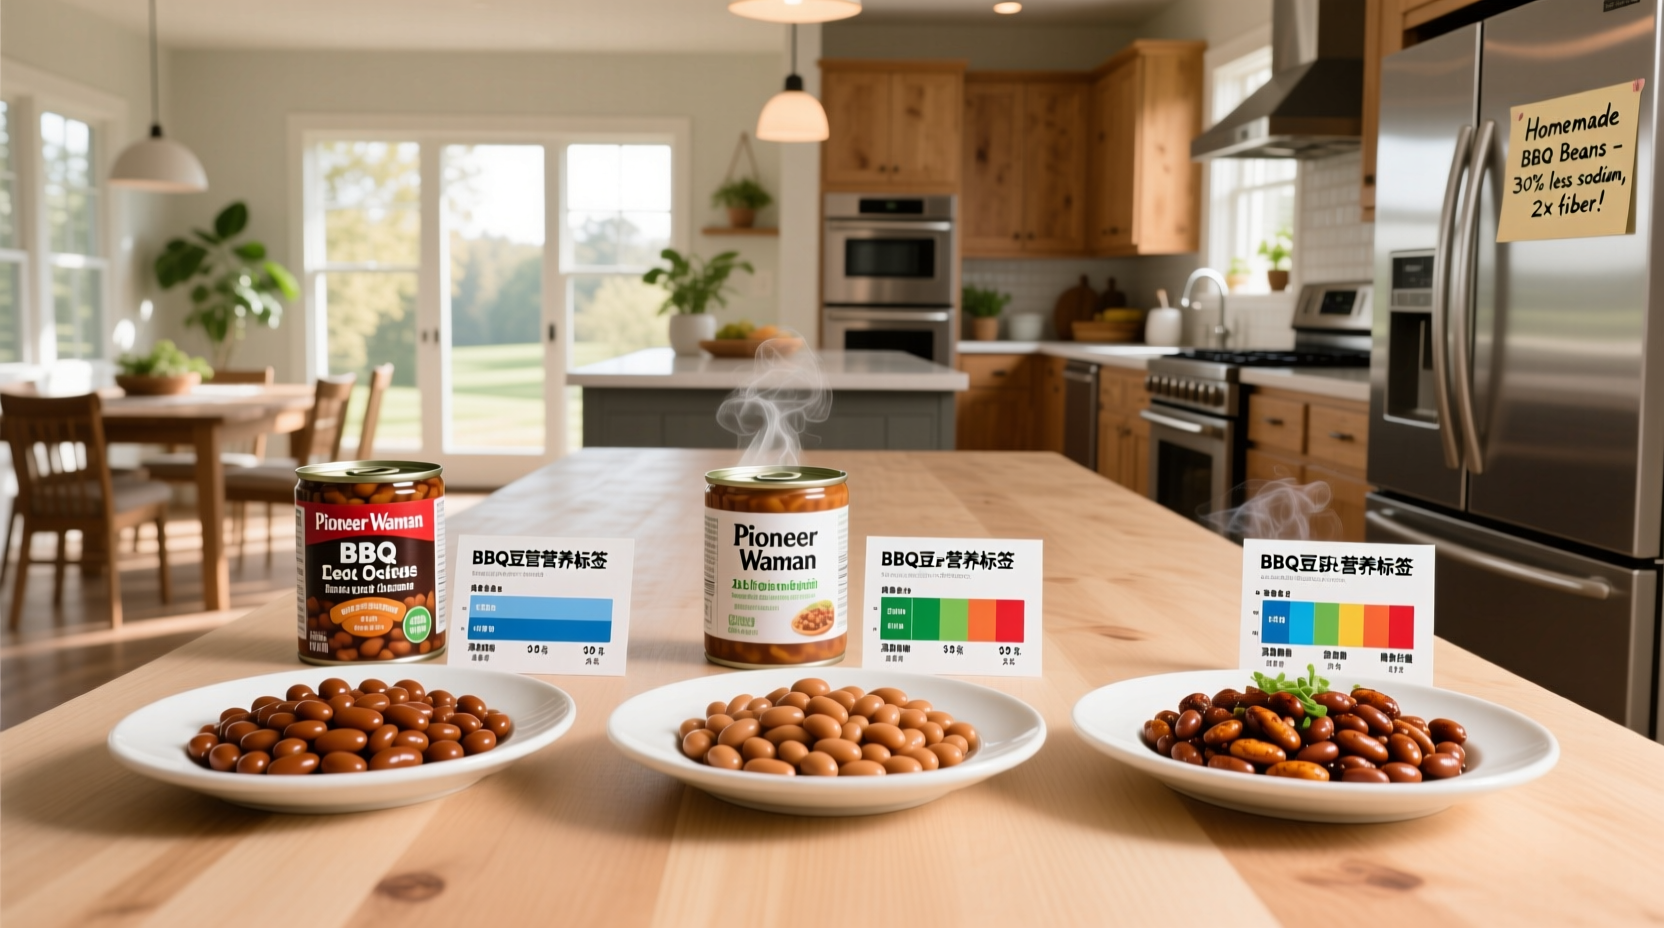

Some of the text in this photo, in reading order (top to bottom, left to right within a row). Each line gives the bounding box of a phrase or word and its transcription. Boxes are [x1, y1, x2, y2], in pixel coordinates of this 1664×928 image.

[1525, 102, 1620, 141] Homemade
[1521, 147, 1553, 168] BBQ
[1559, 142, 1607, 162] Beans
[1512, 173, 1544, 194] 30%
[1549, 170, 1573, 191] less
[1531, 189, 1605, 218] 2x fiber!
[315, 511, 369, 531] Pioneer
[733, 523, 819, 548] Pioneer
[339, 541, 397, 565] BBQ
[739, 548, 817, 571] Waman
